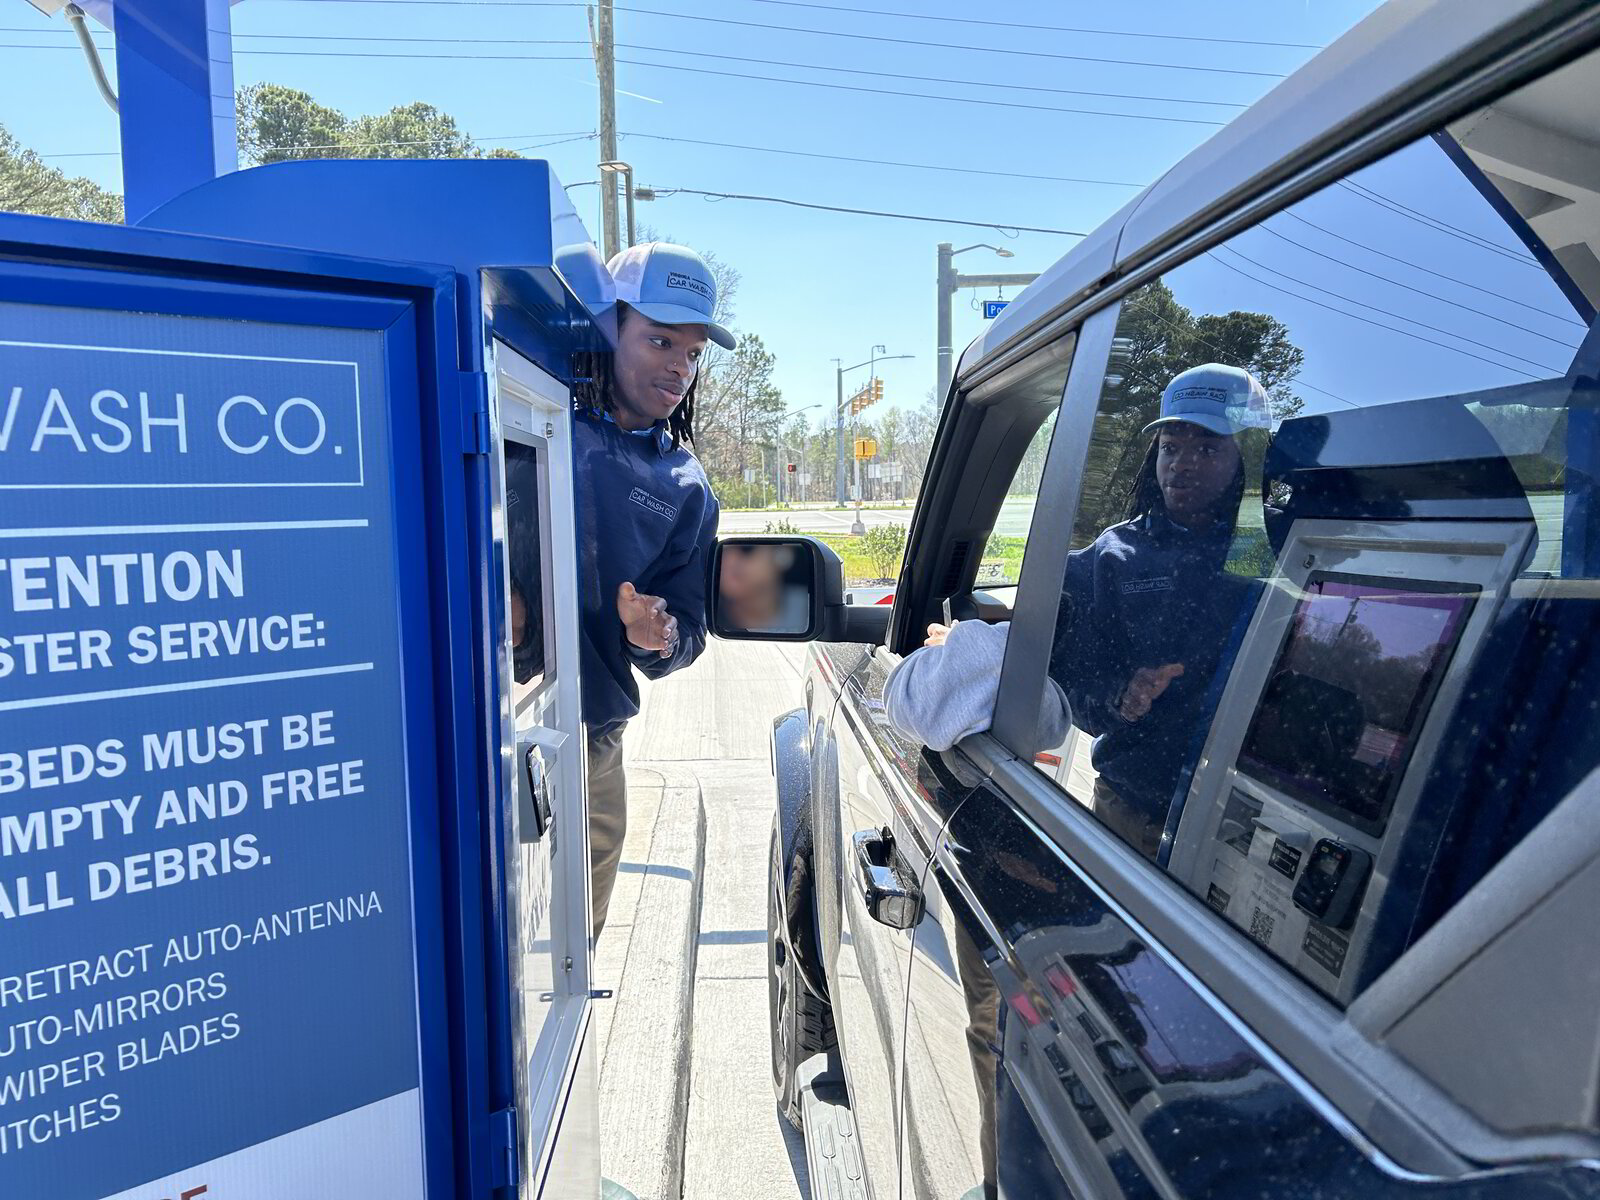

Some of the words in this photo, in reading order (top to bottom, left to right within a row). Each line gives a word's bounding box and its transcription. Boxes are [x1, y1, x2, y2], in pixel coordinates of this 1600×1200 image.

[669, 277, 687, 287] CAR
[689, 282, 708, 294] WASH
[990, 305, 1005, 314] Po
[0, 387, 188, 453] ASH
[217, 395, 343, 455] CO.
[632, 491, 646, 503] CAR
[647, 499, 664, 512] WASH
[0, 549, 244, 612] ENTION
[127, 613, 326, 664] SERVICE:
[0, 738, 127, 794] BEDS
[142, 718, 269, 772] MUST
[282, 710, 335, 751] BE
[0, 795, 142, 857] MPTY
[155, 780, 248, 829] AND
[262, 759, 365, 809] FREE
[88, 833, 272, 901] DEBRIS.
[0, 944, 153, 1007] RETRACT
[163, 890, 383, 967] AUTO-ANTENNA
[0, 1051, 106, 1105] WIPER
[117, 1012, 241, 1072] BLADES
